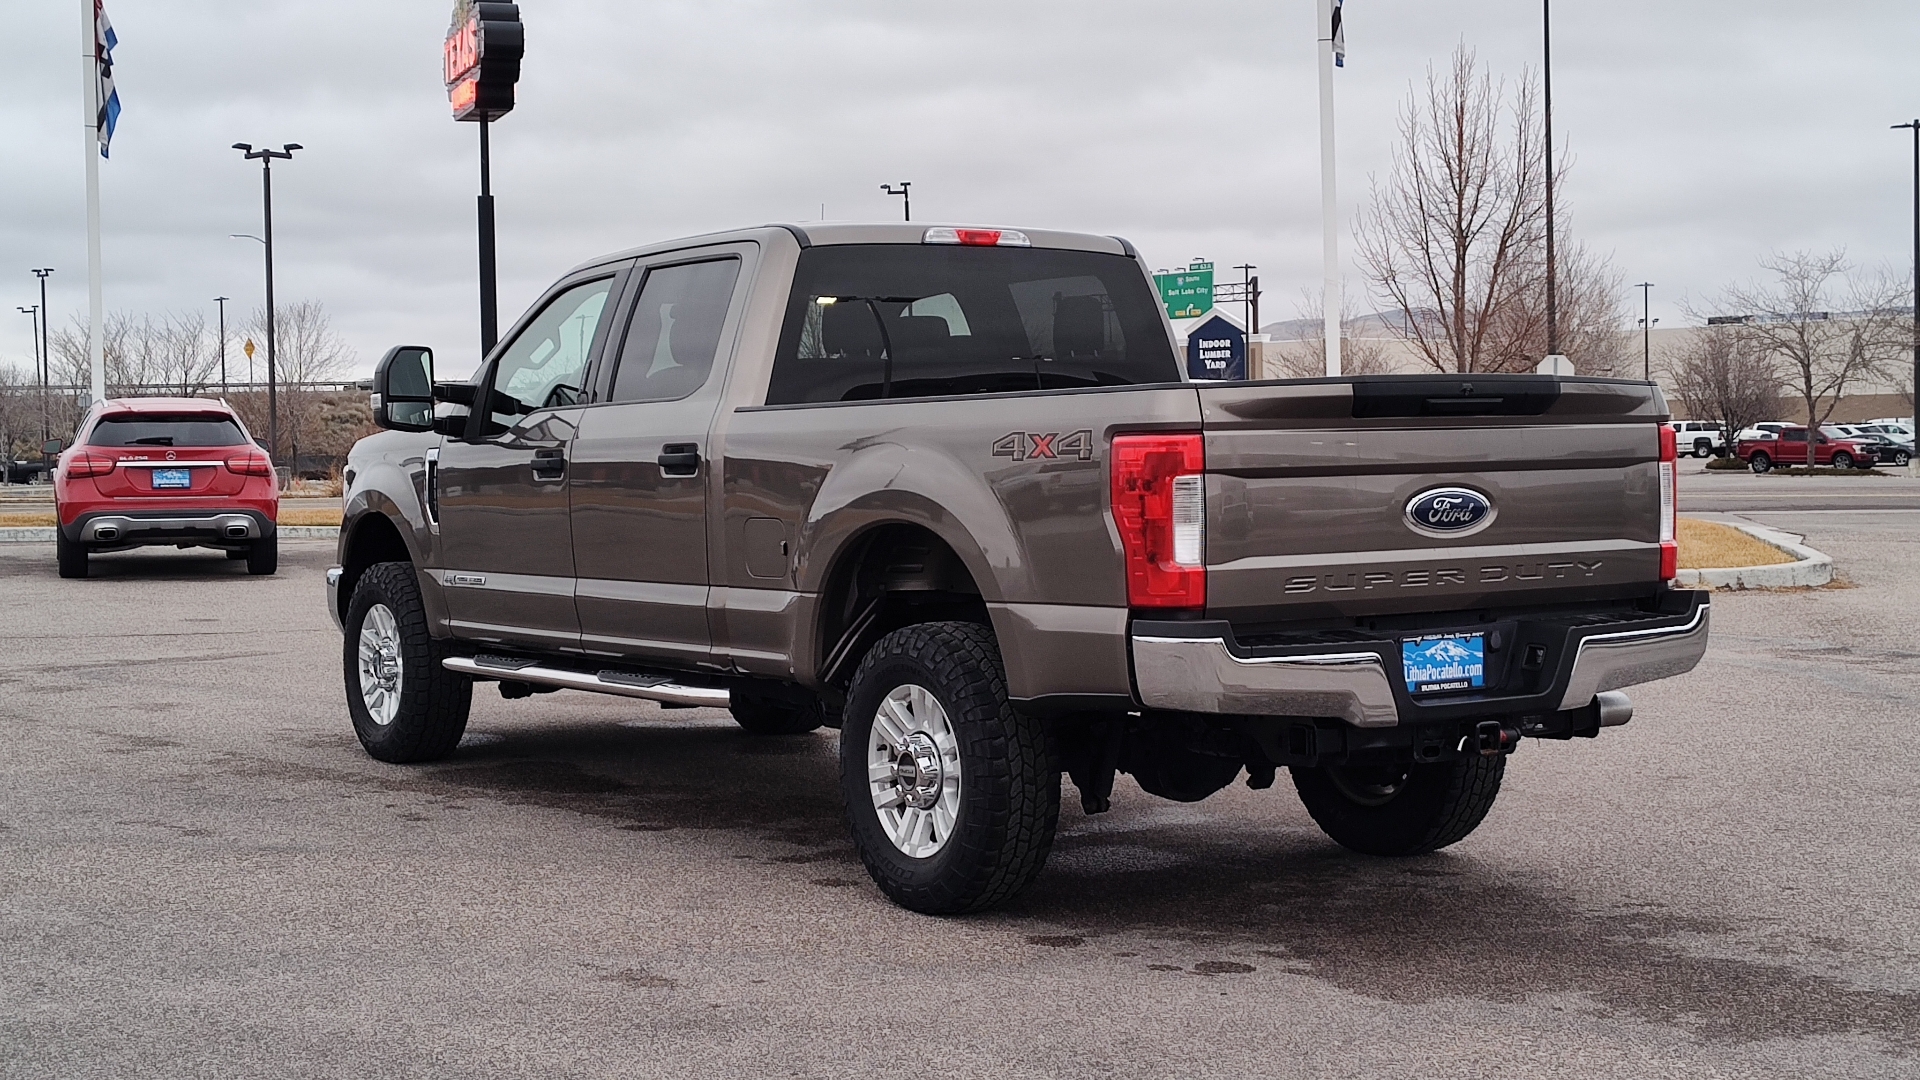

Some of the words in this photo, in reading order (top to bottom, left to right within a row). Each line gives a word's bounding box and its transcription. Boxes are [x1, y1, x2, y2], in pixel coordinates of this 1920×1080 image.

[444, 18, 477, 84] TEXAS
[1199, 339, 1231, 348] INDOOR
[1200, 350, 1231, 359] LUMBER
[1205, 360, 1226, 369] YARD
[1428, 497, 1475, 523] Ford
[1284, 569, 1465, 593] SUPER
[1480, 562, 1603, 583] DUTY
[1404, 662, 1482, 682] LithiaPocatello.com
